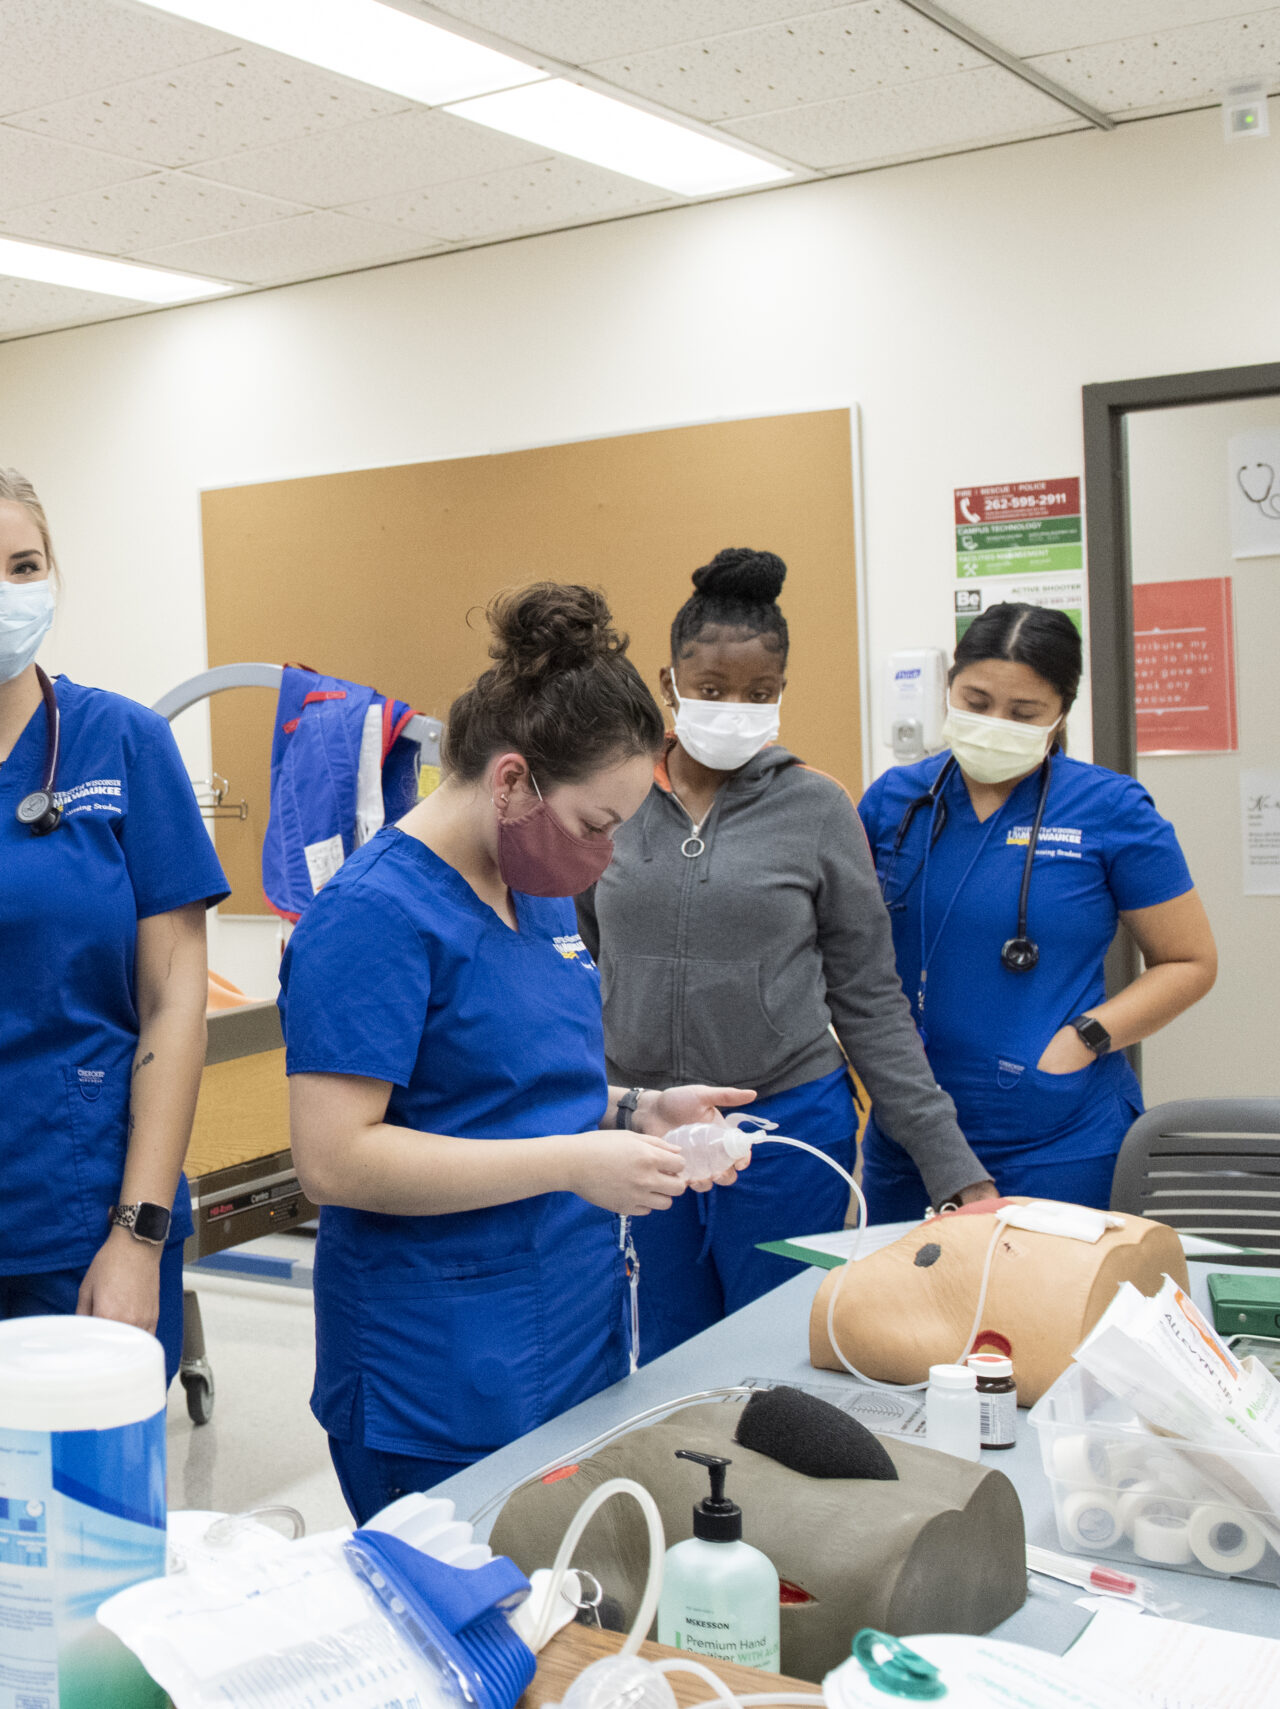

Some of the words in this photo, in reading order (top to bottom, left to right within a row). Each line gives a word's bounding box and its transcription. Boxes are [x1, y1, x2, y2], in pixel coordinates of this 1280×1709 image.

[980, 486, 1010, 495] RESCUE
[1018, 482, 1046, 491] POLICE
[985, 493, 1066, 511] 262-595-2911
[958, 526, 989, 535] CAMPUS
[991, 522, 1042, 533] TECHNOLOGY
[1190, 641, 1207, 651] my
[1163, 654, 1177, 664] to
[1161, 667, 1193, 679] gave
[1167, 681, 1190, 692] any
[1035, 849, 1056, 858] ursing
[1164, 1313, 1214, 1375] ALLEVYN
[686, 1633, 737, 1651] Premium
[739, 1635, 767, 1651] Hand
